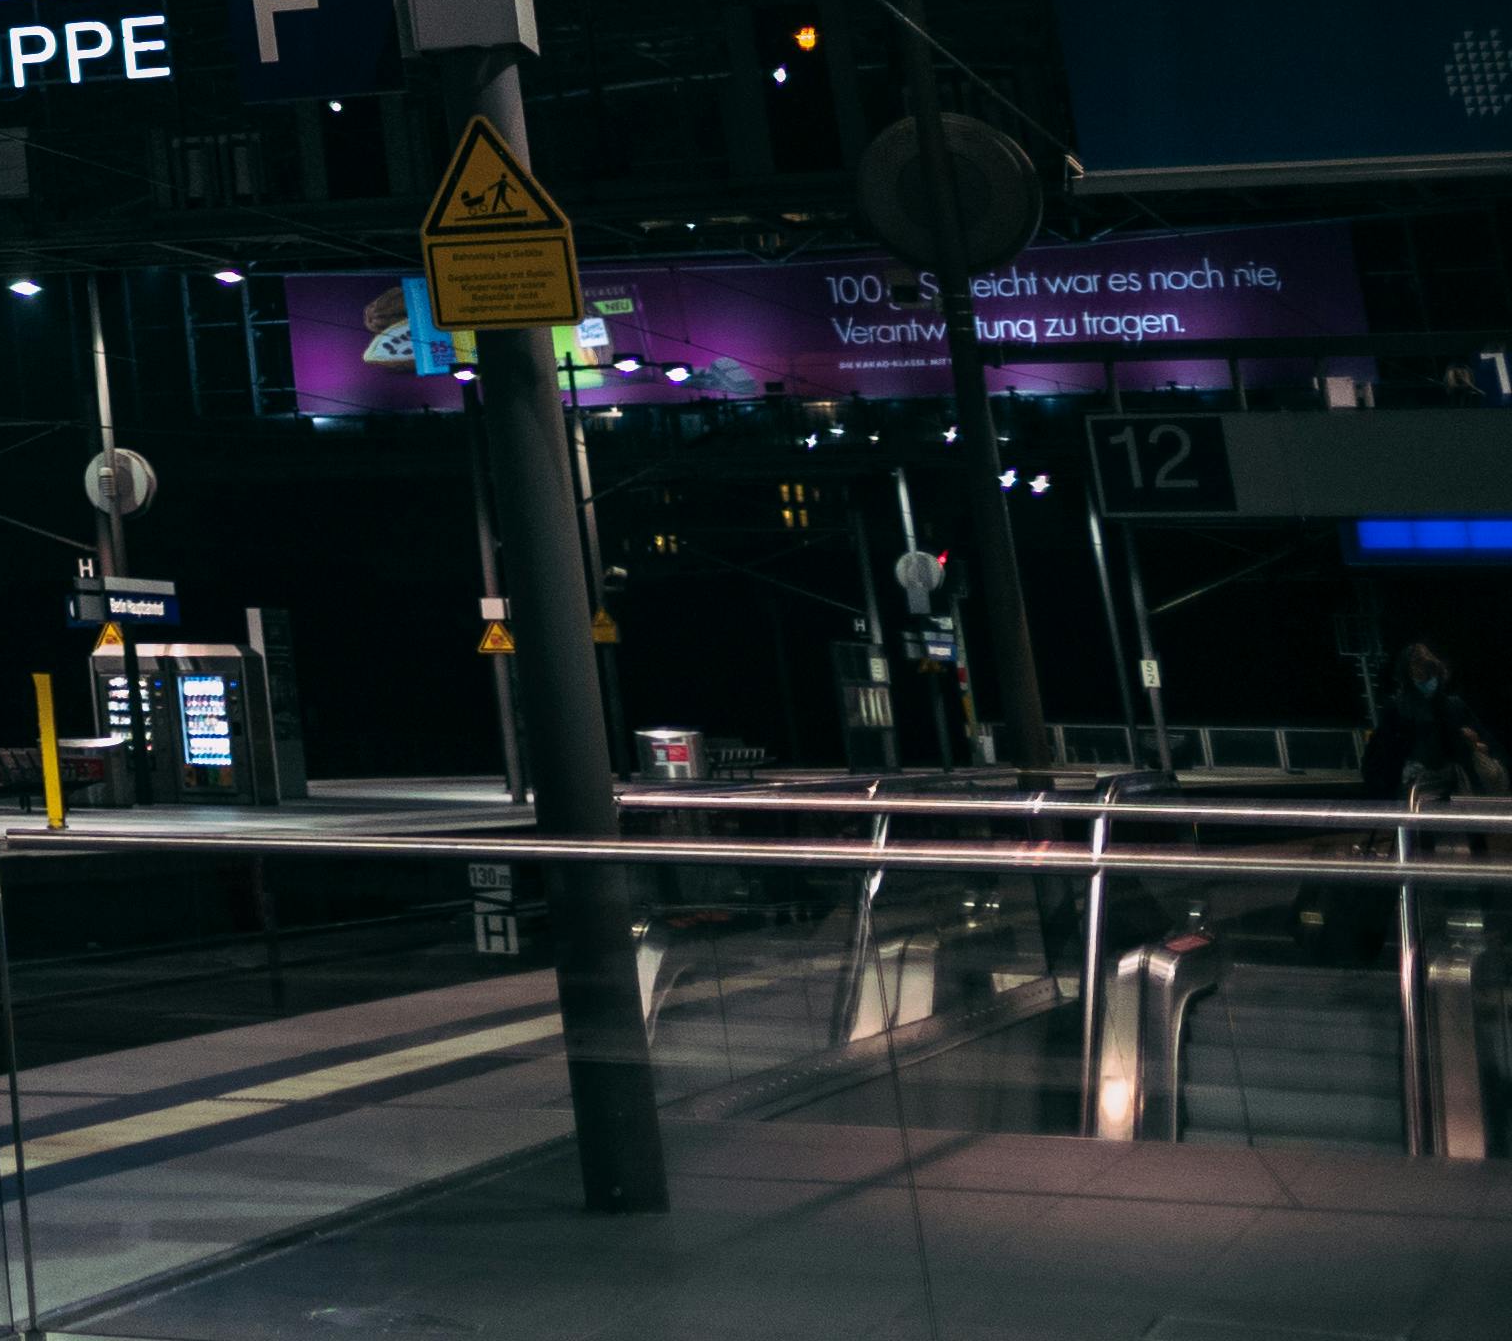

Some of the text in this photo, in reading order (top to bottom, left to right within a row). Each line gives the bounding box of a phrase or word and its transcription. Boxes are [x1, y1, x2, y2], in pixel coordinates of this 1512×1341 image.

[824, 274, 882, 304] 100
[1044, 273, 1100, 294] war
[1107, 272, 1142, 292] es
[1148, 257, 1224, 292] noch
[1233, 261, 1282, 293] nie,
[830, 310, 1187, 345] Verantwtung zu tragen.
[1108, 424, 1200, 489] 12
[77, 557, 95, 578] H
